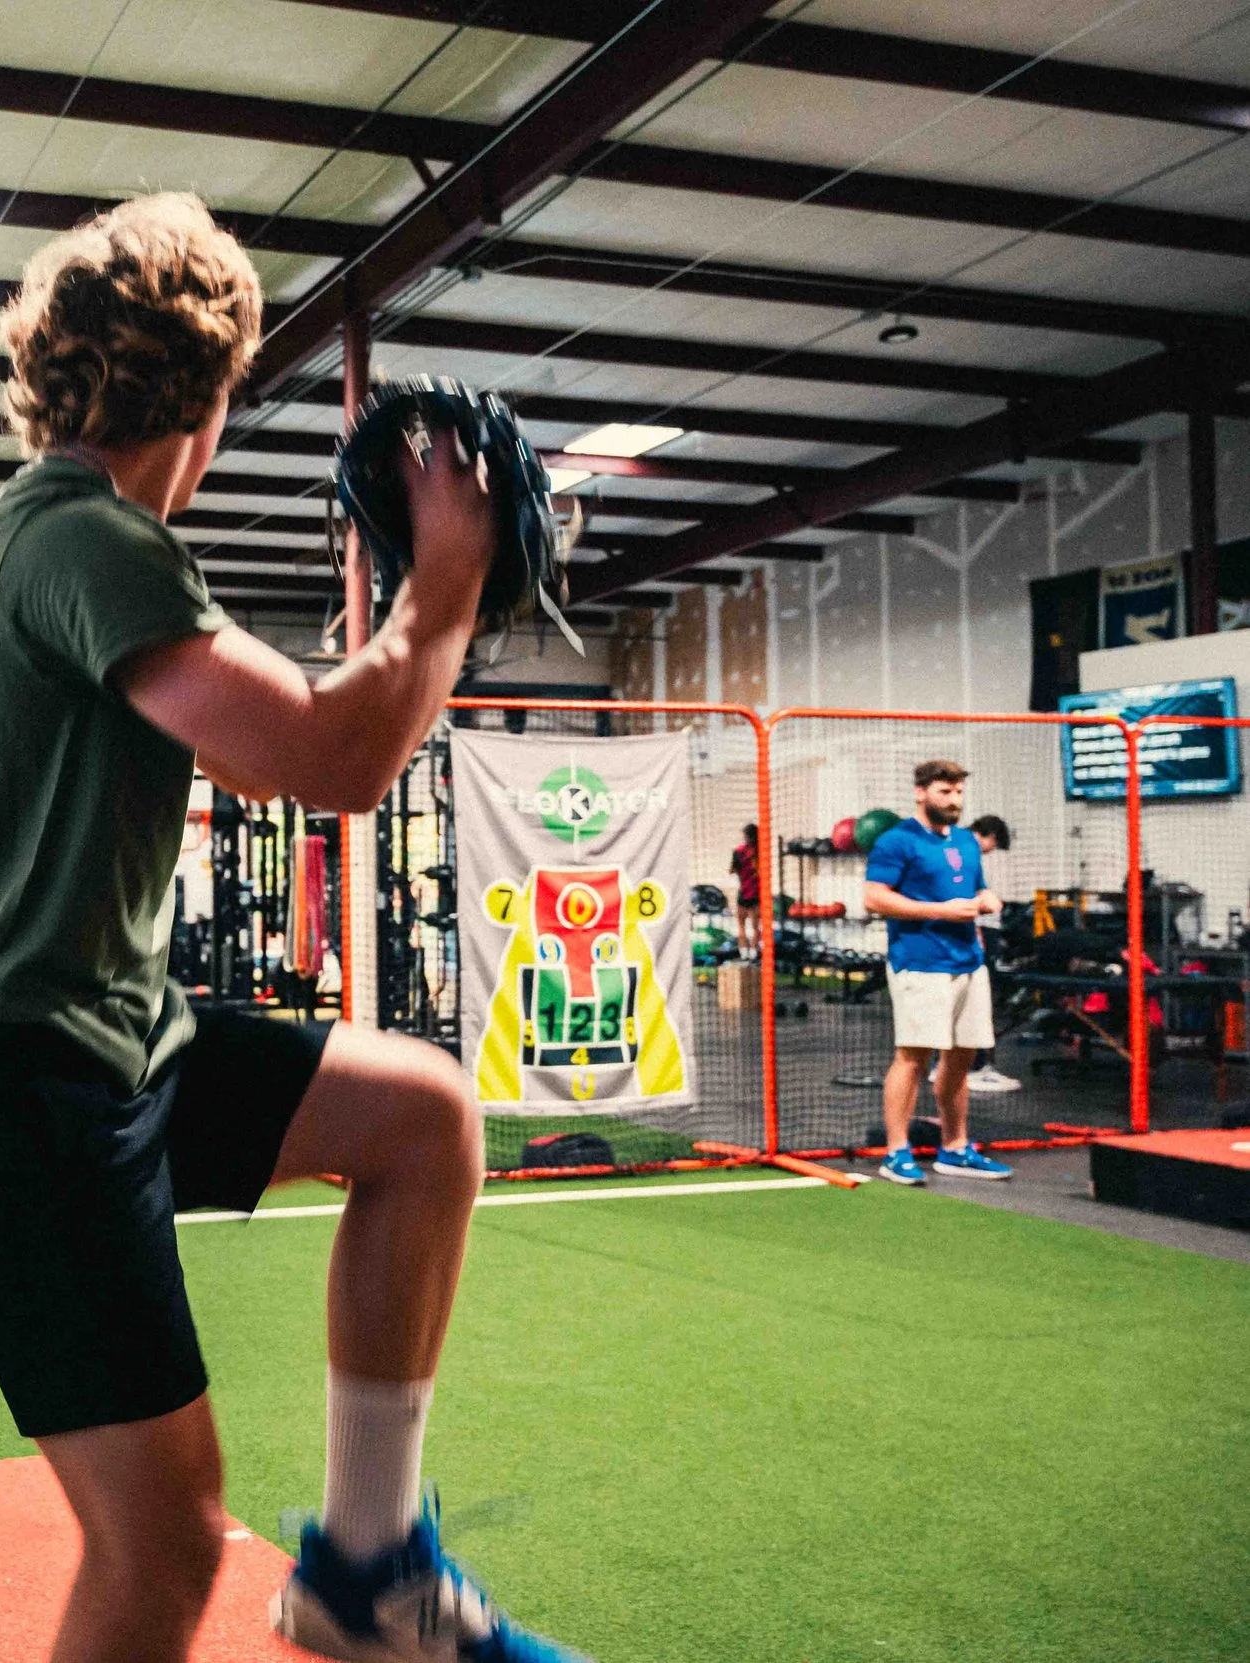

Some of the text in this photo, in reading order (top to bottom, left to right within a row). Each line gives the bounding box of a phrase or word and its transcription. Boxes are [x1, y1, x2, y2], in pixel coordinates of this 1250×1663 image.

[497, 889, 513, 919] 7
[638, 886, 657, 916] 8
[539, 1001, 620, 1041] 1 2 3
[571, 1046, 590, 1067] 4
